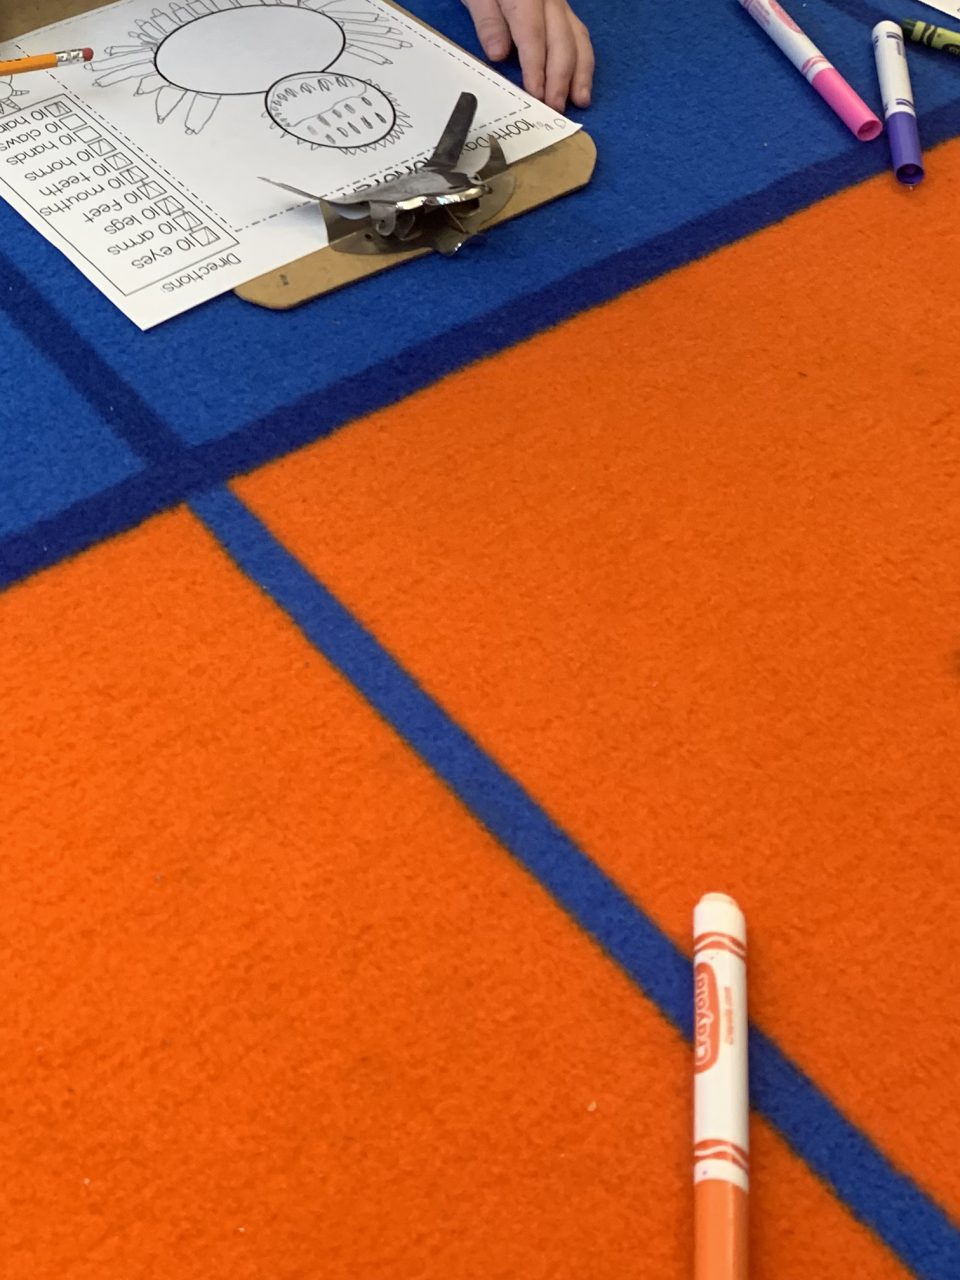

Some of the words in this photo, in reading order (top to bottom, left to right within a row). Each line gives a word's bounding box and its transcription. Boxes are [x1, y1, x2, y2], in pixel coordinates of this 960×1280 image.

[30, 108, 49, 121] 10
[44, 121, 63, 134] 10
[58, 132, 77, 146] 10
[6, 140, 60, 166] hands
[76, 148, 95, 162] 10
[24, 156, 78, 181] horns
[92, 163, 112, 177] 10
[39, 171, 91, 197] teeth
[107, 176, 126, 190] 10
[40, 184, 106, 217] mouths
[123, 191, 143, 204] 10
[82, 199, 123, 223] feet
[141, 206, 161, 220] 10
[104, 214, 142, 235] legs
[158, 221, 178, 235] 10
[107, 229, 155, 255] arms
[176, 233, 196, 251] 10
[131, 245, 173, 269] eyes
[695, 972, 714, 1067] Crayola
